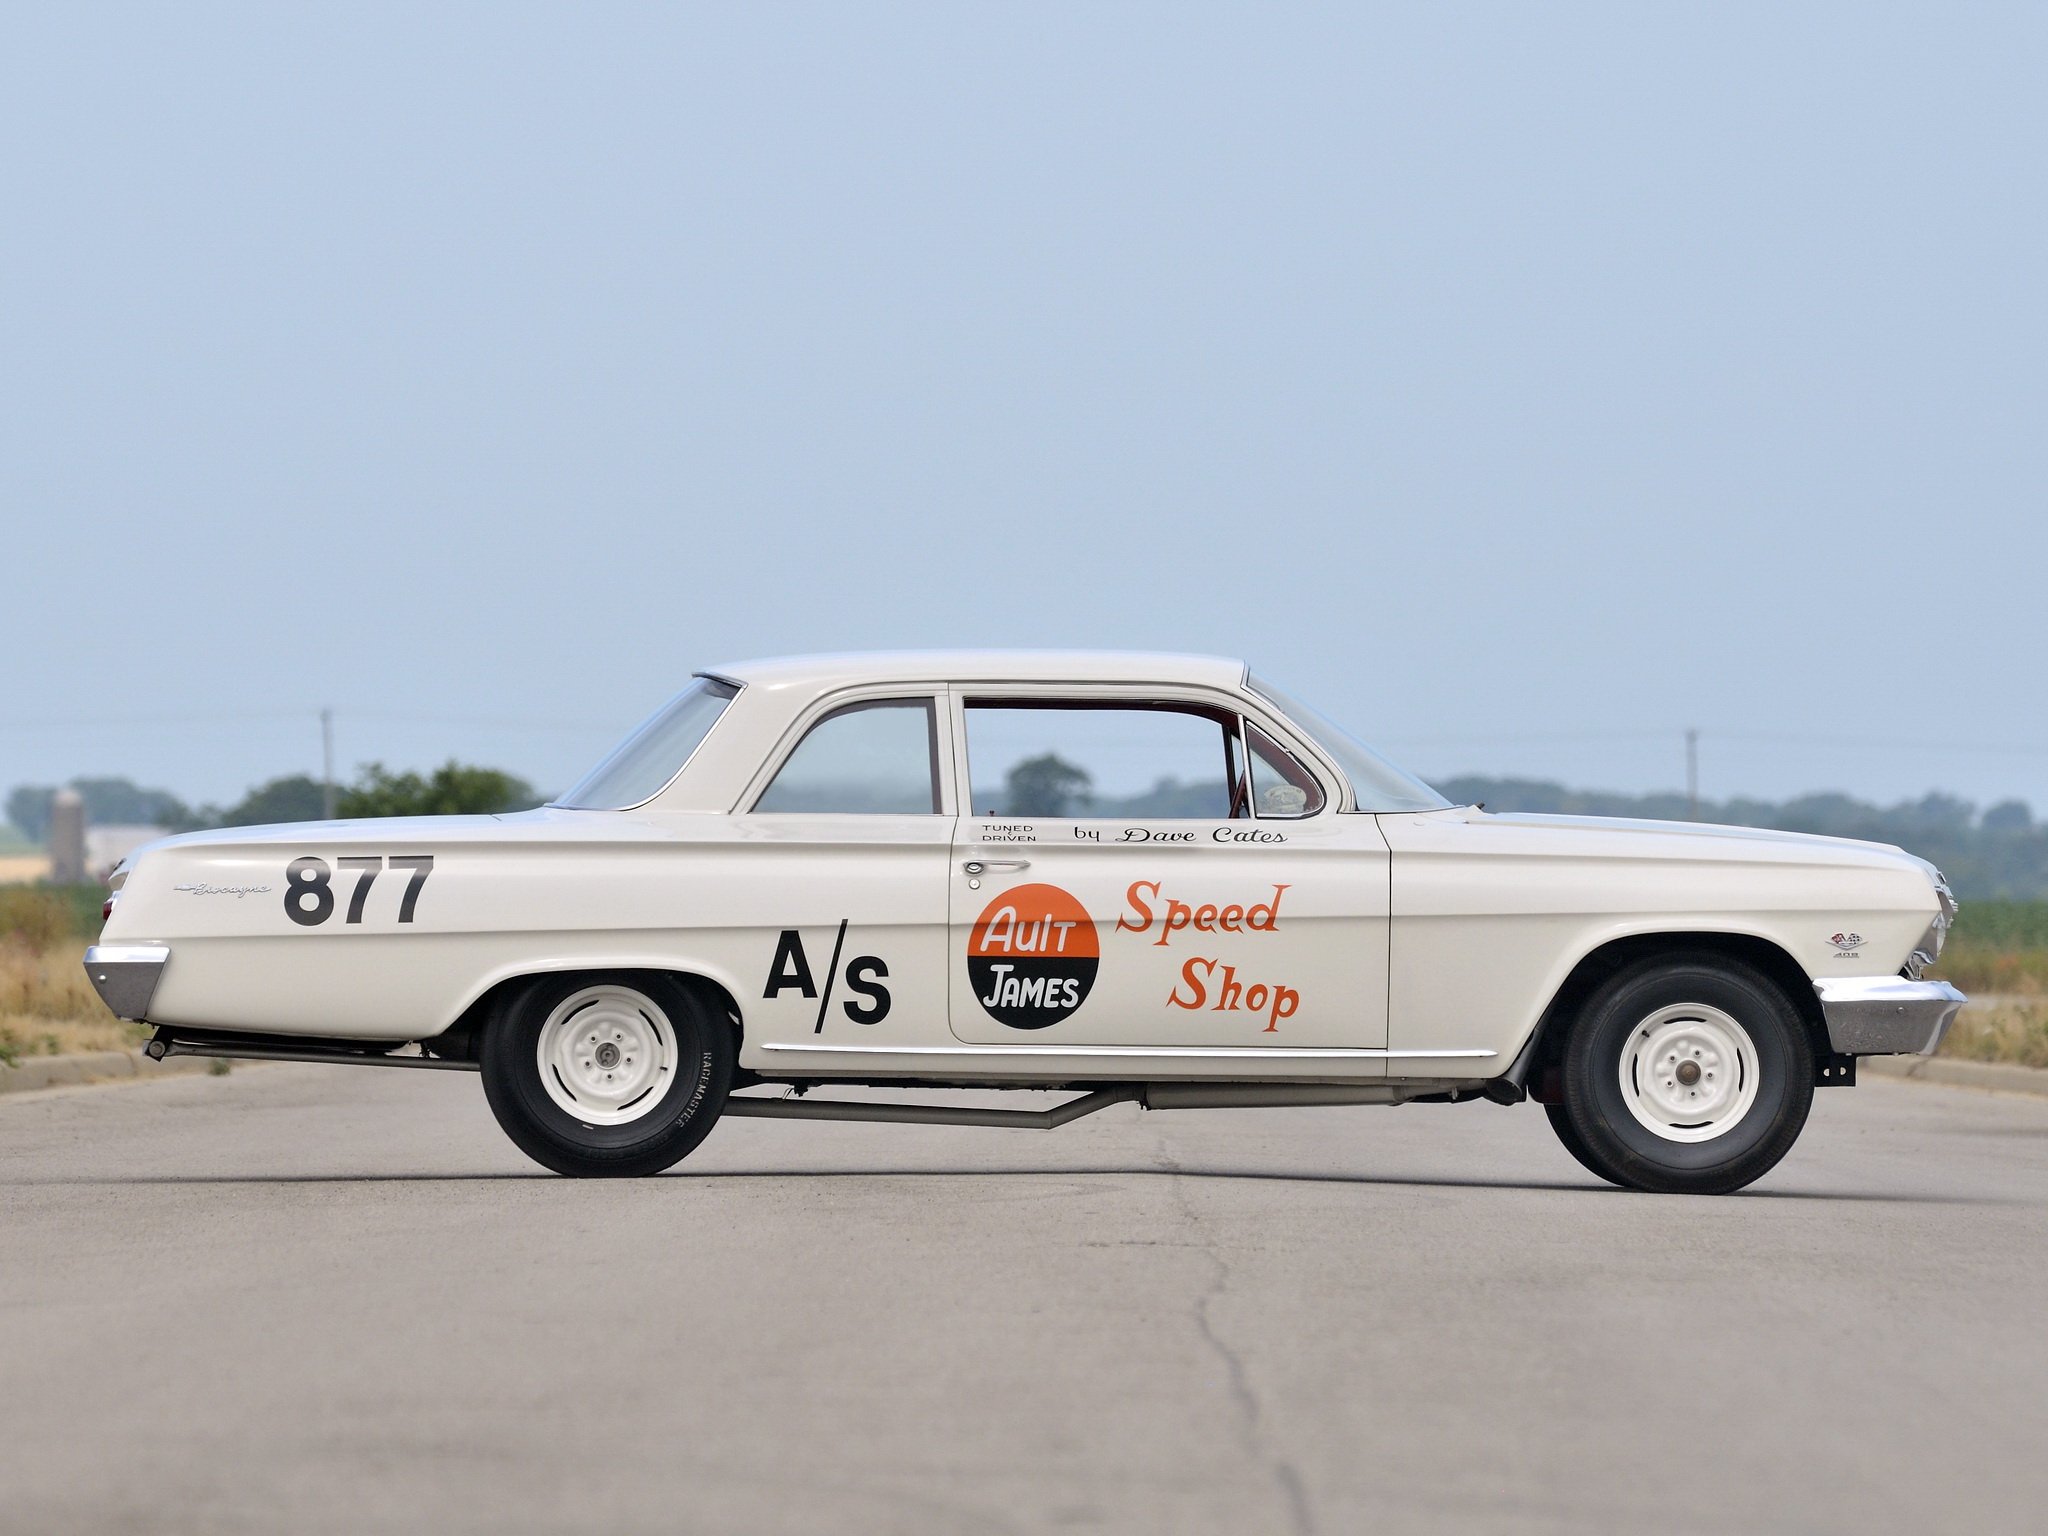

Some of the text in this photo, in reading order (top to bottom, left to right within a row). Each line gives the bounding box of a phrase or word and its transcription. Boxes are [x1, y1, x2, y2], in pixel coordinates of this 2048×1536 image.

[1074, 826, 1288, 843] by Dave Cates
[284, 855, 434, 926] 877
[1115, 880, 1292, 946] Speed
[763, 919, 891, 1033] A/S
[983, 964, 1079, 1008] JAMES
[1166, 957, 1300, 1032] Shop
[675, 1052, 712, 1128] RACEMASTER
